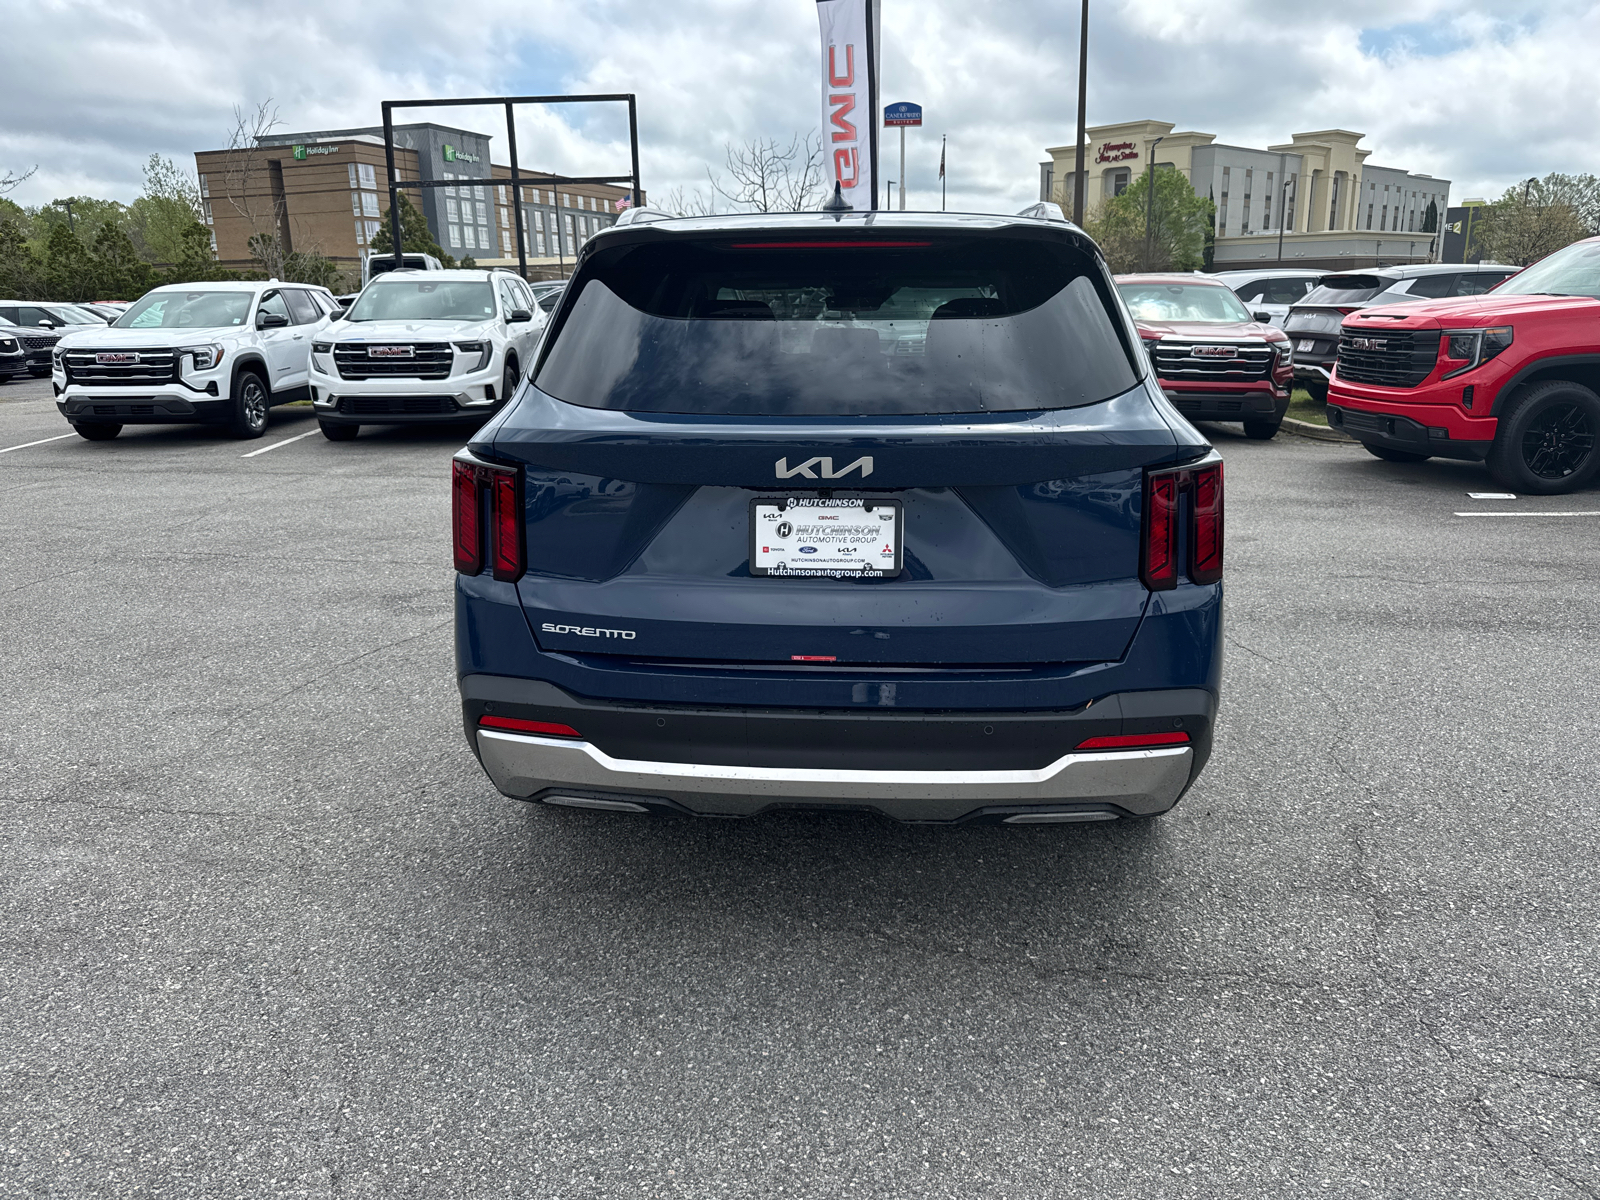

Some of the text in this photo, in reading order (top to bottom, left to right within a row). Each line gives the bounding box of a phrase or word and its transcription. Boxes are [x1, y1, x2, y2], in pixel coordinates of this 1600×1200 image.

[306, 145, 339, 156] Holiday Inn
[1098, 141, 1137, 154] Hampton
[455, 150, 480, 163] Holiday Inn
[1095, 153, 1112, 164] Inn
[1118, 151, 1139, 161] Suites
[1352, 338, 1388, 352] GMC
[370, 347, 411, 357] GMC
[1195, 346, 1236, 356] GMC
[97, 353, 136, 363] GMC
[775, 456, 874, 479] KIA
[799, 499, 864, 507] HUTCHINSON
[795, 524, 882, 536] HUTCHINSON
[796, 536, 877, 544] AUTOMOTIVE GROUP
[767, 567, 883, 578] Hutchinsonautogroup.com
[541, 623, 636, 640] SORENTO
